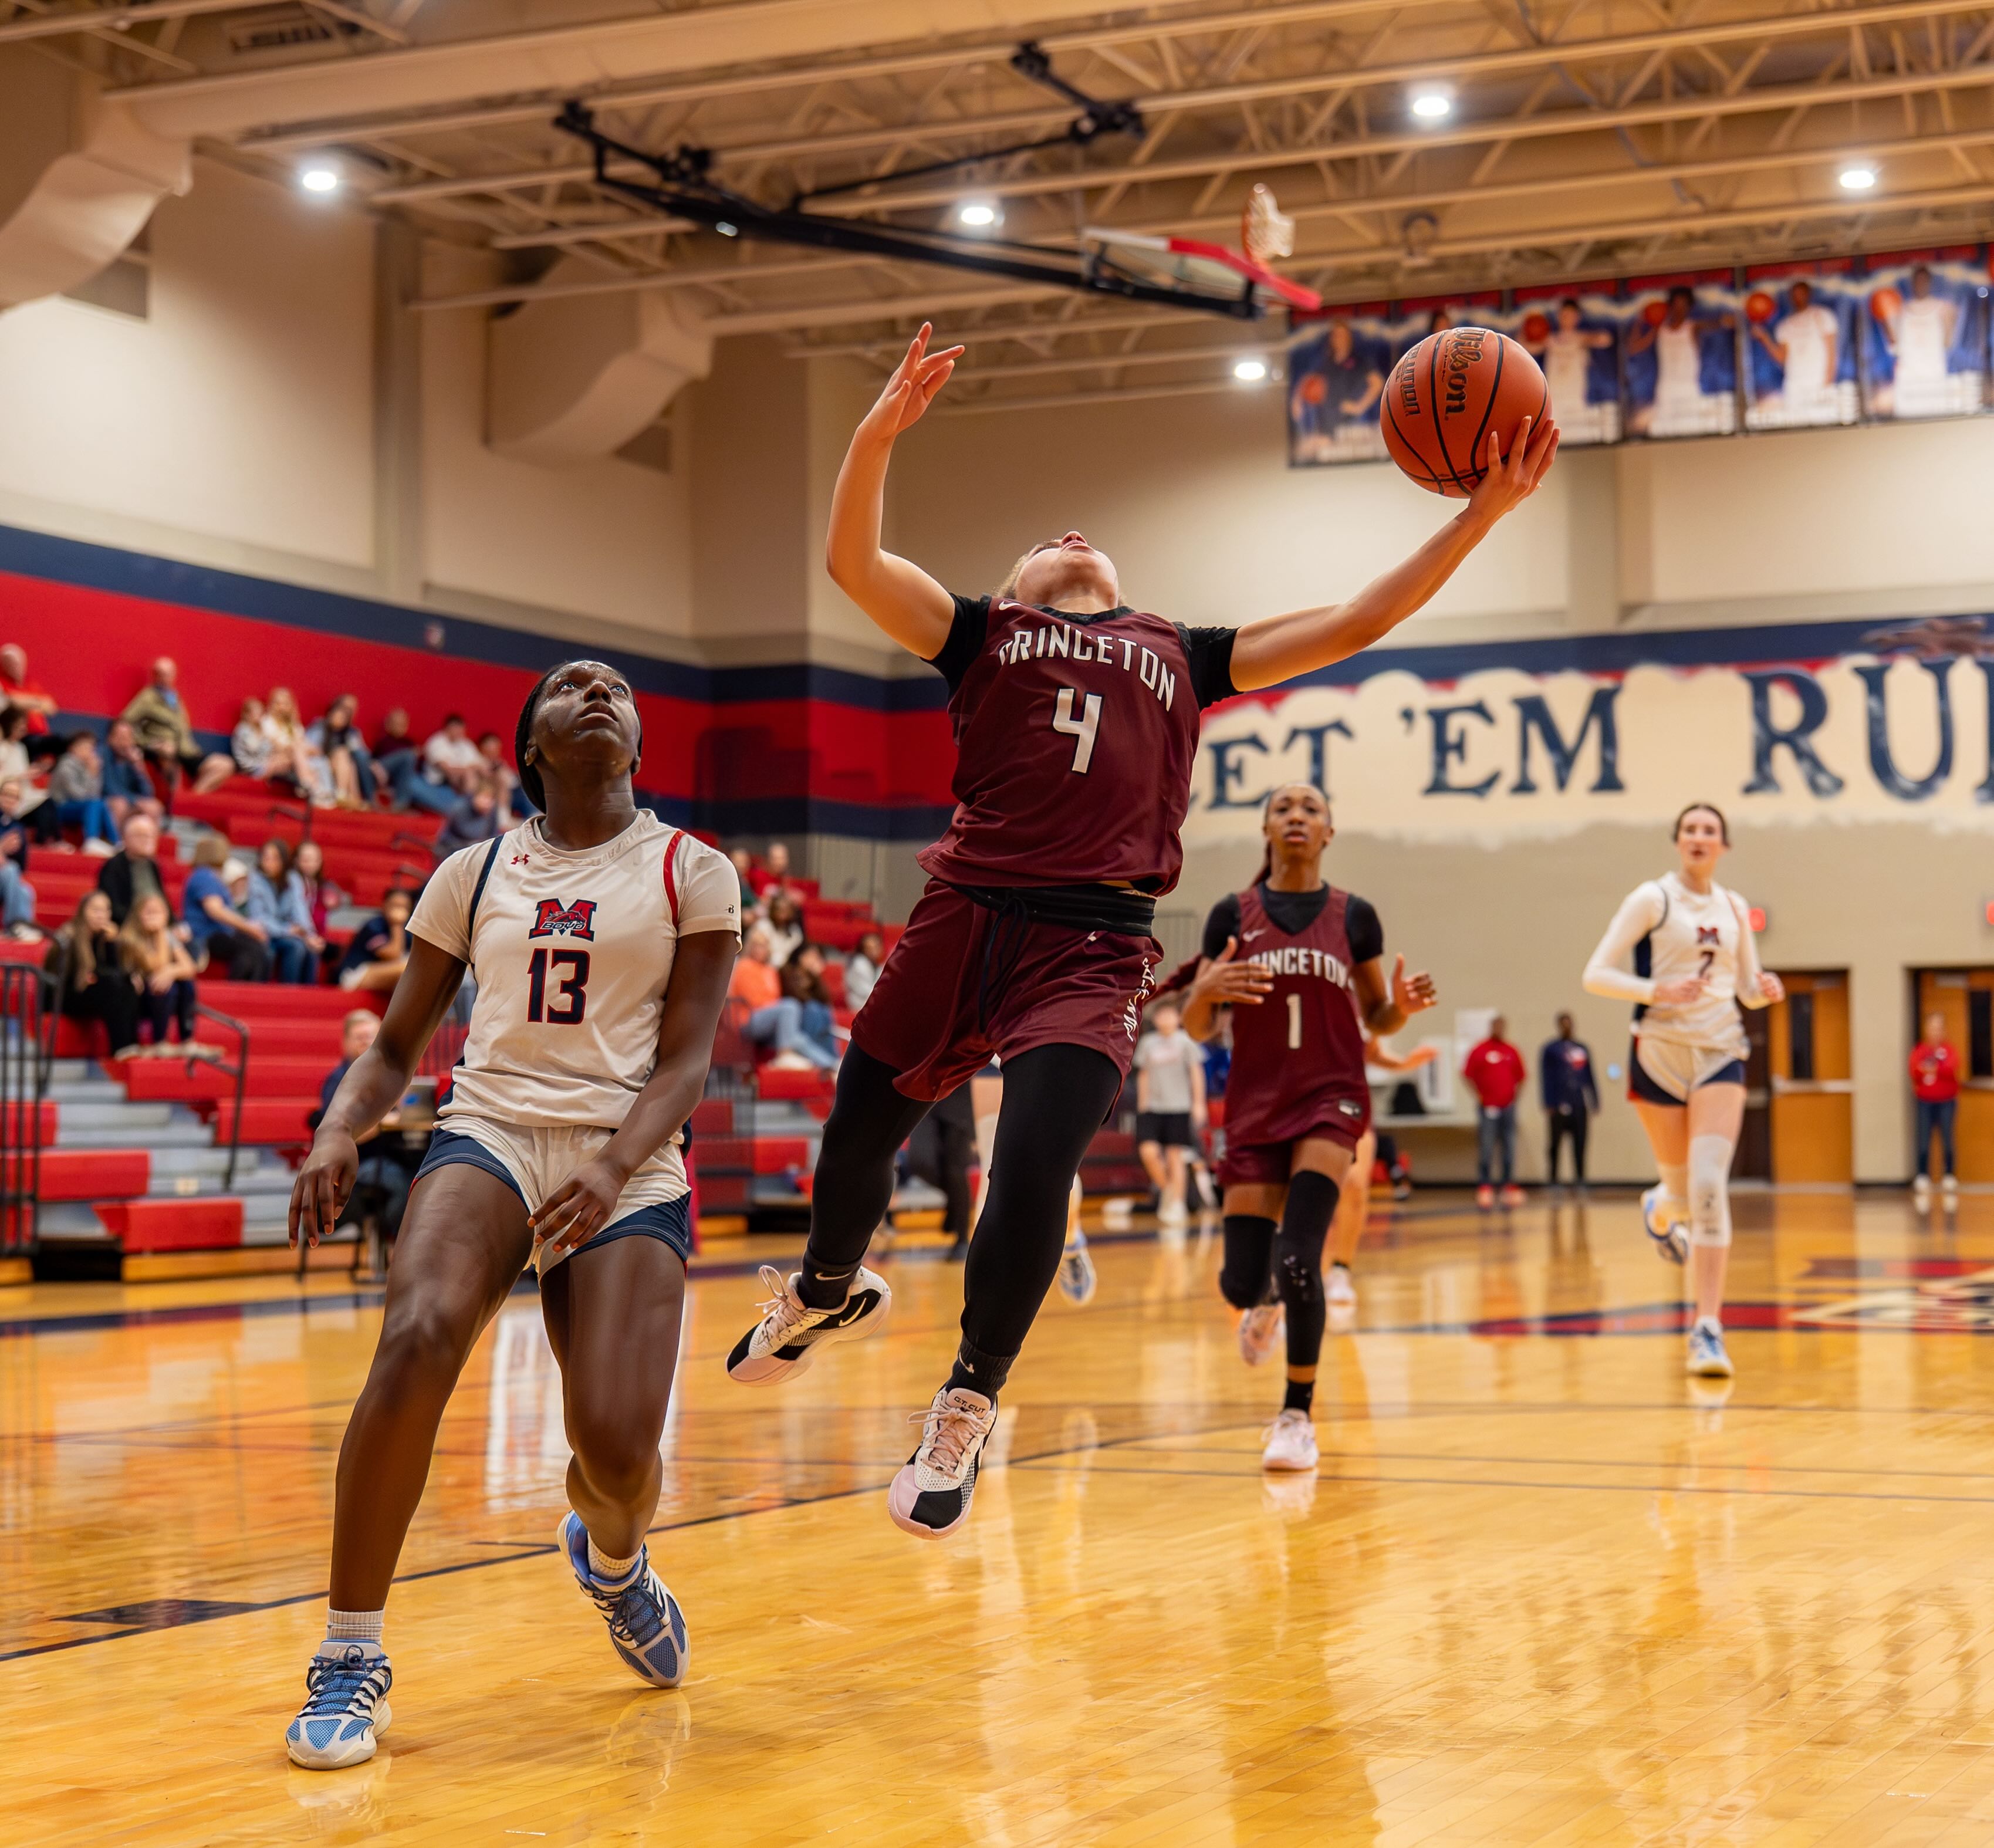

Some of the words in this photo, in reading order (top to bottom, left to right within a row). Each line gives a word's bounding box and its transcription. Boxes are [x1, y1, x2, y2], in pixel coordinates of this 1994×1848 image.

[1053, 688, 1102, 774] 4
[1188, 719, 1354, 811] ET
[528, 898, 597, 942] M
[541, 920, 586, 931] BOYD
[528, 948, 590, 1024] 13
[1248, 947, 1348, 990] INCETON
[1287, 994, 1302, 1049] 1
[969, 1404, 985, 1413] CUT
